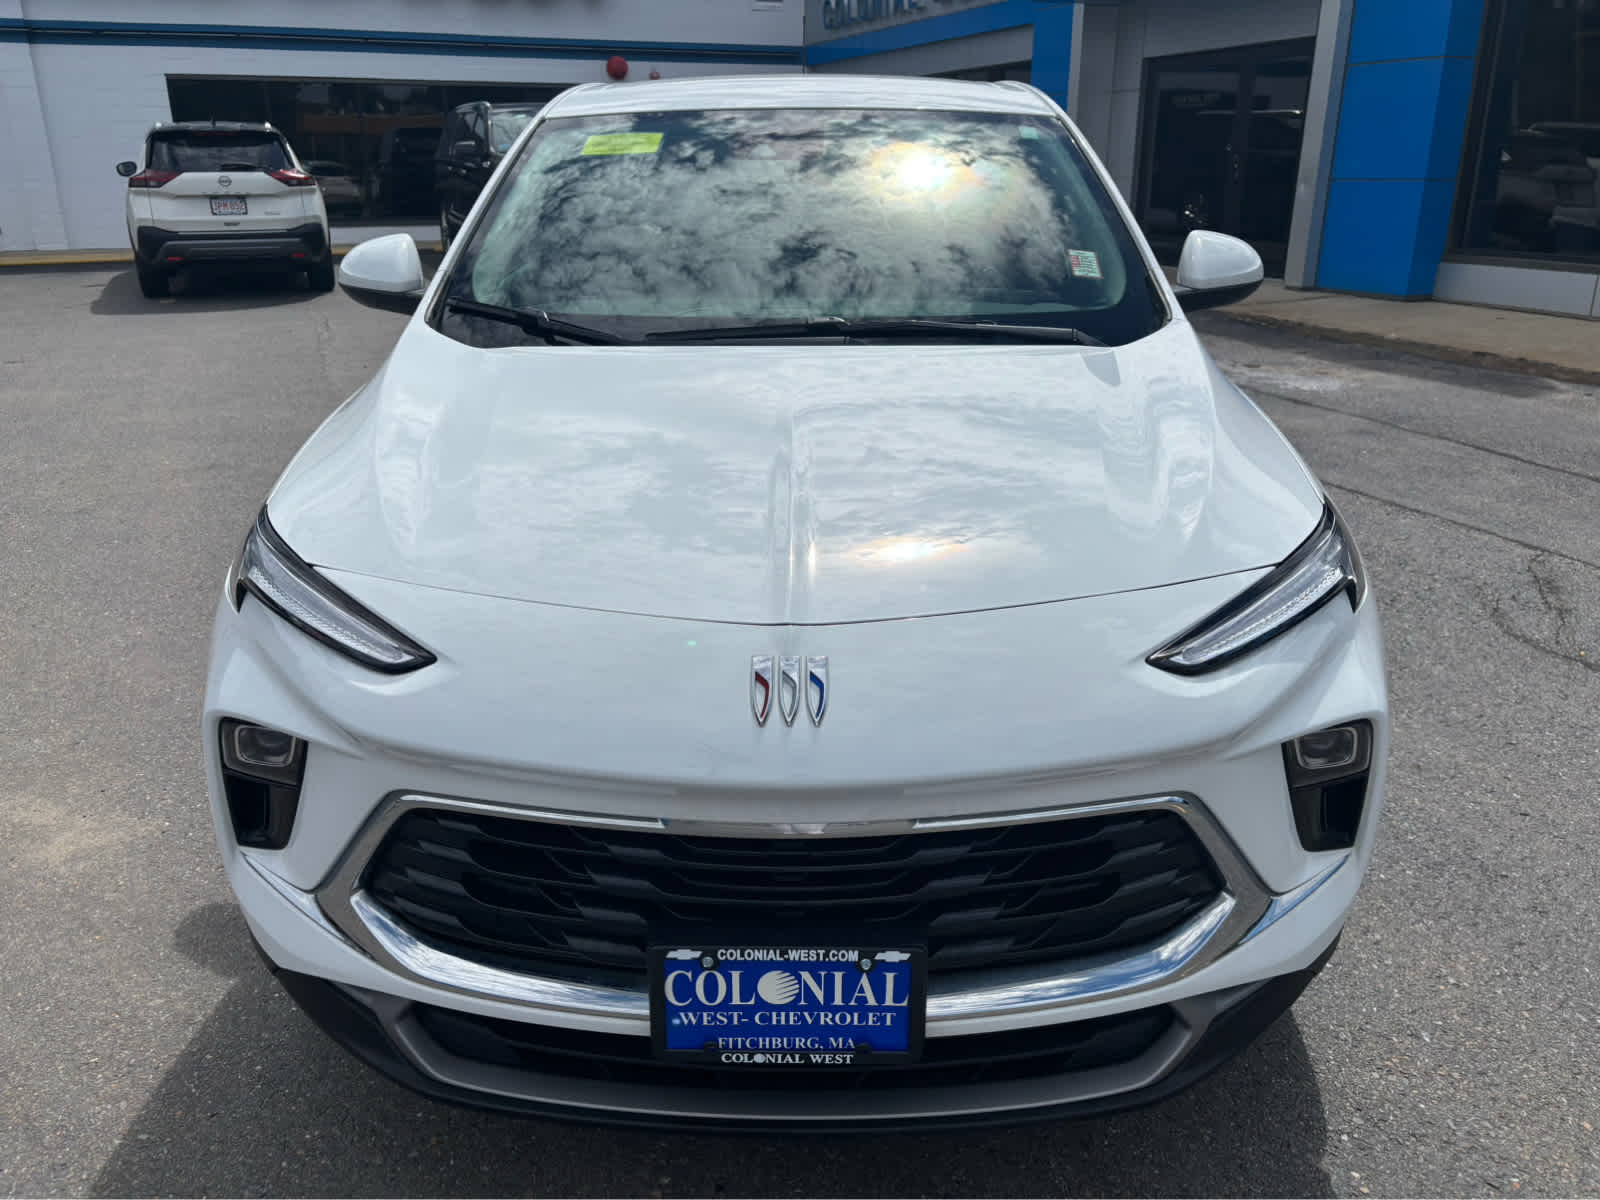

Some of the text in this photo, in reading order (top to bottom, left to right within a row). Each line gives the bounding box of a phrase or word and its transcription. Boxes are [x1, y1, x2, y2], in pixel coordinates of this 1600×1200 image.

[717, 949, 859, 962] COLONIAL-WEST.COM
[664, 970, 909, 1007] COLONIAL
[829, 1037, 855, 1049] MA
[721, 1053, 854, 1064] COLONIAL WEST
